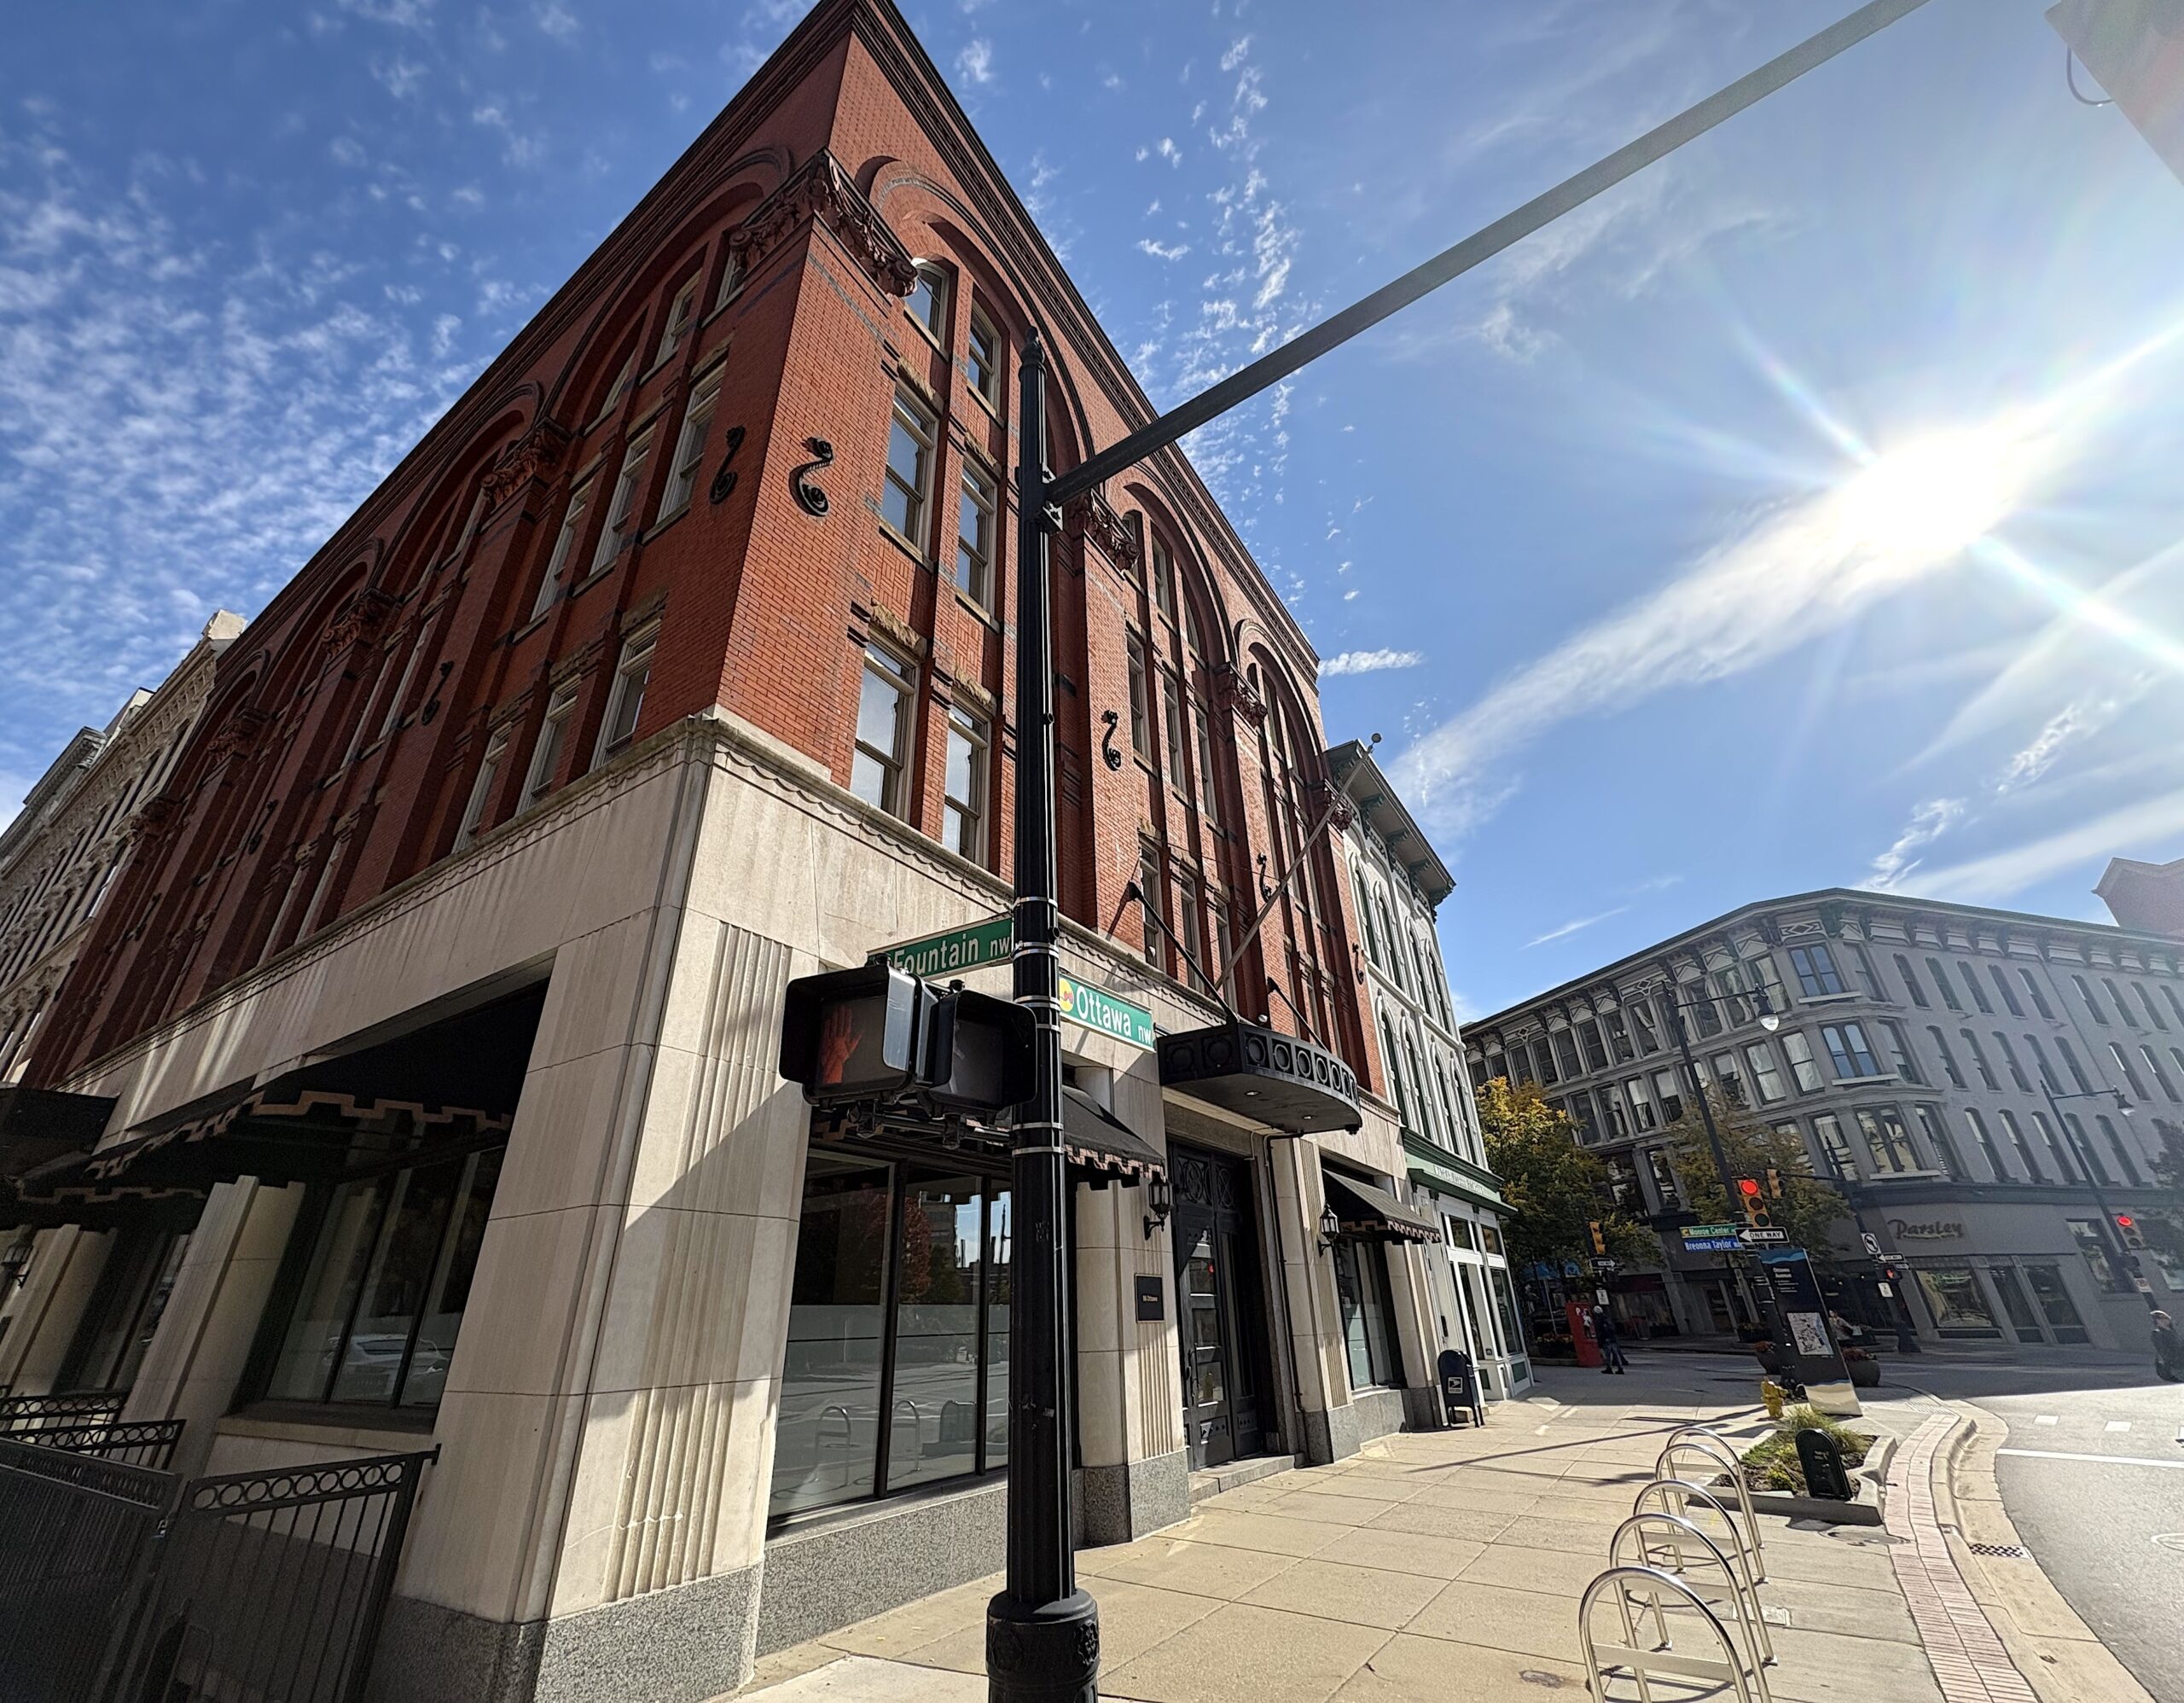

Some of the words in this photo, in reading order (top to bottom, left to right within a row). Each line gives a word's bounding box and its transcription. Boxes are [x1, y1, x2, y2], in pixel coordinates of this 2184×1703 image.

[894, 933, 979, 975] Fountain
[990, 936, 1010, 957] nw
[1077, 985, 1132, 1037] Ottawa
[1138, 1025, 1152, 1045] nw
[1887, 1218, 1964, 1240] Parsley
[1684, 1241, 1711, 1251] Breonna
[1711, 1240, 1732, 1251] Taylor
